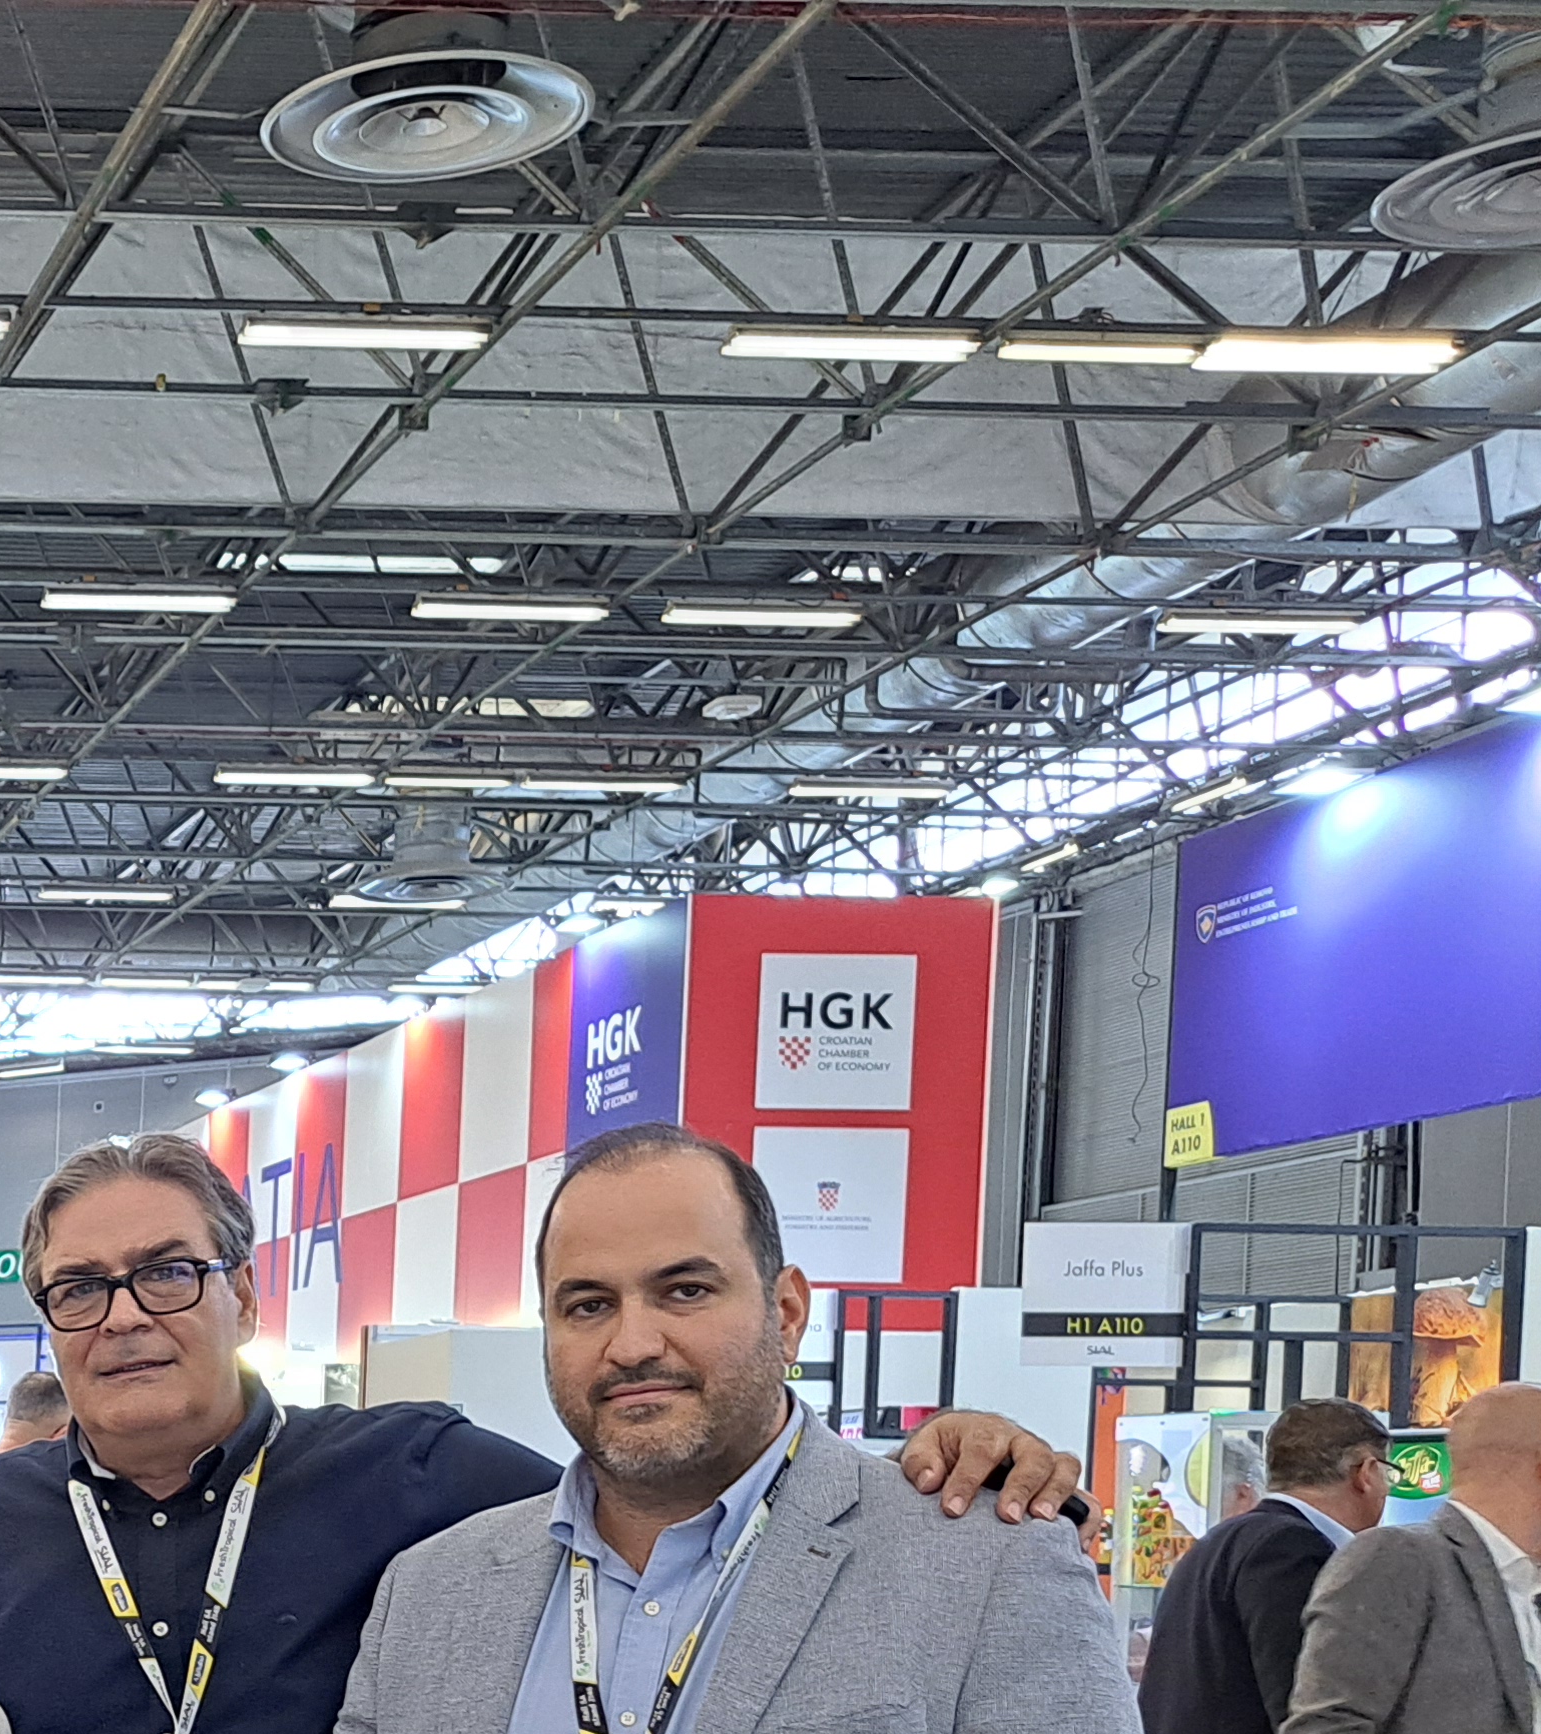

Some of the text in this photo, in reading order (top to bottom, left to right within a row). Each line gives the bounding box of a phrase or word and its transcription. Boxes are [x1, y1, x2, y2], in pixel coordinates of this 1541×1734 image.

[780, 991, 893, 1030] HGK
[586, 1005, 642, 1068] HGK
[819, 1036, 872, 1046] CROATIAN
[818, 1049, 869, 1058] CHAMBER
[818, 1062, 890, 1071] OF ECONOMY
[1170, 1113, 1205, 1133] HALL 1
[1171, 1135, 1202, 1156] A110
[1064, 1260, 1144, 1278] Jaffa Plus
[1067, 1317, 1143, 1335] H1 A110
[1086, 1345, 1115, 1356] SIAL
[76, 1494, 105, 1544] FreshTropical
[213, 1517, 237, 1577] FreshTropical
[571, 1573, 590, 1663] FreshTropical SIAL
